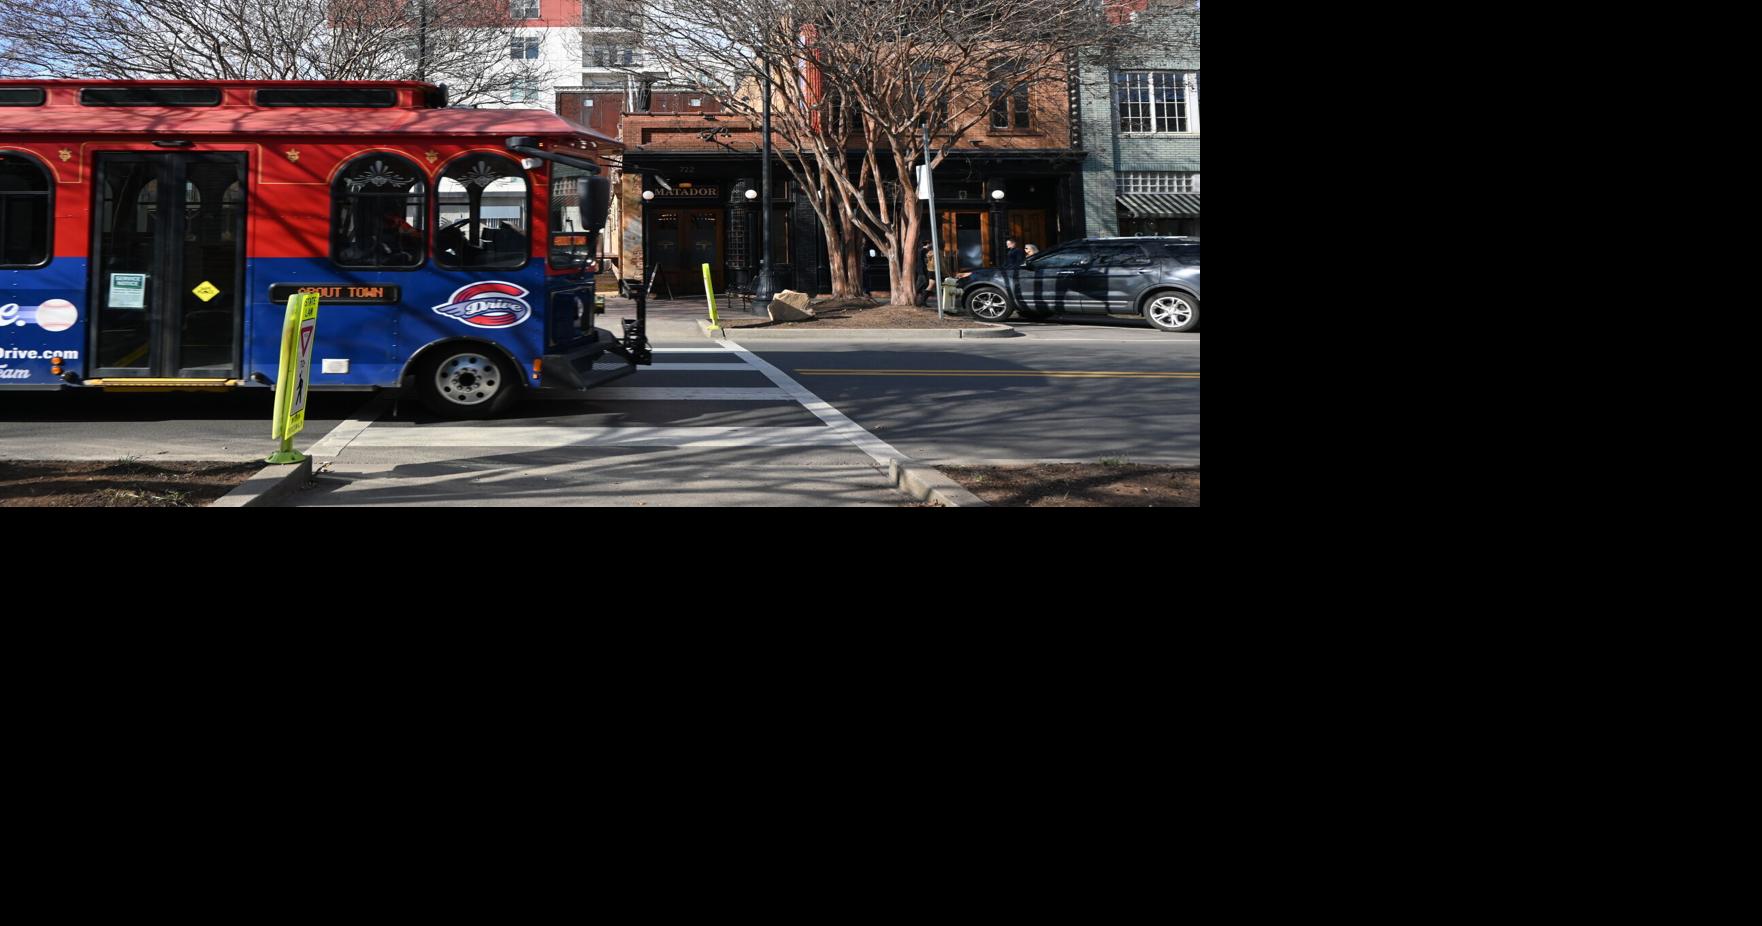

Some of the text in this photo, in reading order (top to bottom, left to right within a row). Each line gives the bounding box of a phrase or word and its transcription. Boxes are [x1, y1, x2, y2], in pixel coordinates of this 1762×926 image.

[655, 188, 717, 196] MATADOR
[347, 287, 384, 298] TOWN
[465, 299, 522, 314] Drive
